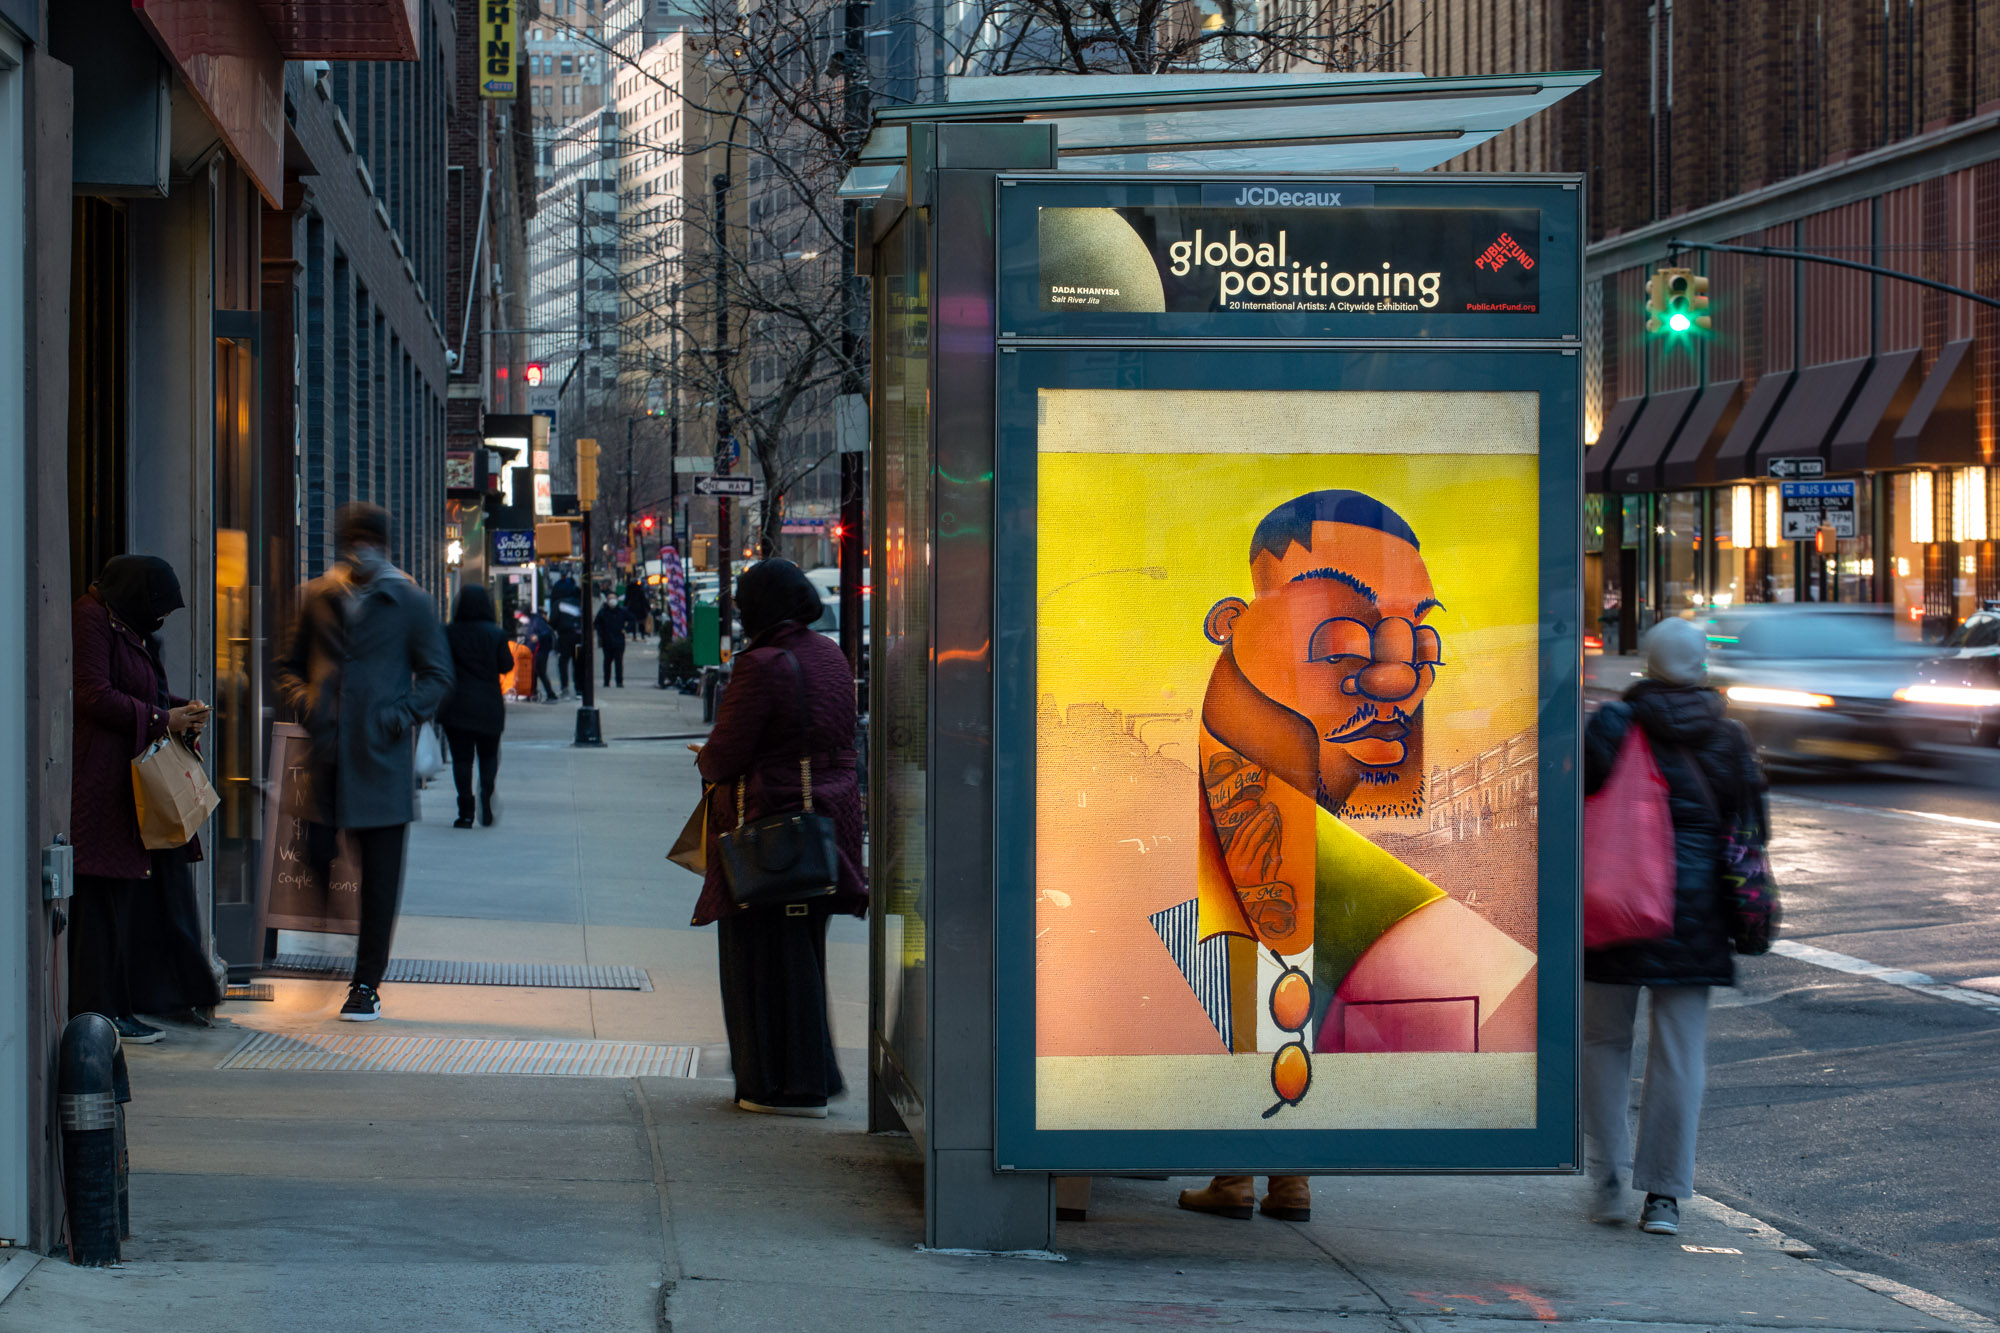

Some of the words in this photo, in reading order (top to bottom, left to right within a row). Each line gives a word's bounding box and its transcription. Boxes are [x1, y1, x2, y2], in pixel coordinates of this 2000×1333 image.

[487, 0, 509, 75] HING
[1235, 187, 1341, 207] JCDecaux
[1169, 229, 1286, 277] global
[1475, 232, 1512, 270] PUBLIC
[1507, 240, 1535, 270] FUND
[1491, 247, 1512, 272] ART
[1220, 261, 1441, 308] positioning
[1052, 286, 1075, 294] DADA
[1077, 287, 1120, 296] KHANYISA
[1052, 295, 1066, 303] Salt
[1067, 296, 1086, 304] River
[1087, 297, 1100, 305] Jita
[1229, 301, 1240, 310] 20
[1242, 301, 1295, 310] International
[1297, 301, 1327, 311] Artists:
[1328, 302, 1336, 310] A
[1337, 301, 1375, 313] Citywide
[1376, 301, 1419, 311] Exhibition
[1466, 303, 1536, 312] PublicArtFund.org
[703, 481, 719, 490] ONE
[728, 482, 746, 490] WAY
[1799, 484, 1820, 495] BUS
[1823, 484, 1851, 495] LANE
[1787, 497, 1820, 507] BUSES
[1823, 497, 1849, 506] ONLY
[497, 536, 531, 549] Smoke
[500, 549, 529, 557] SHOP
